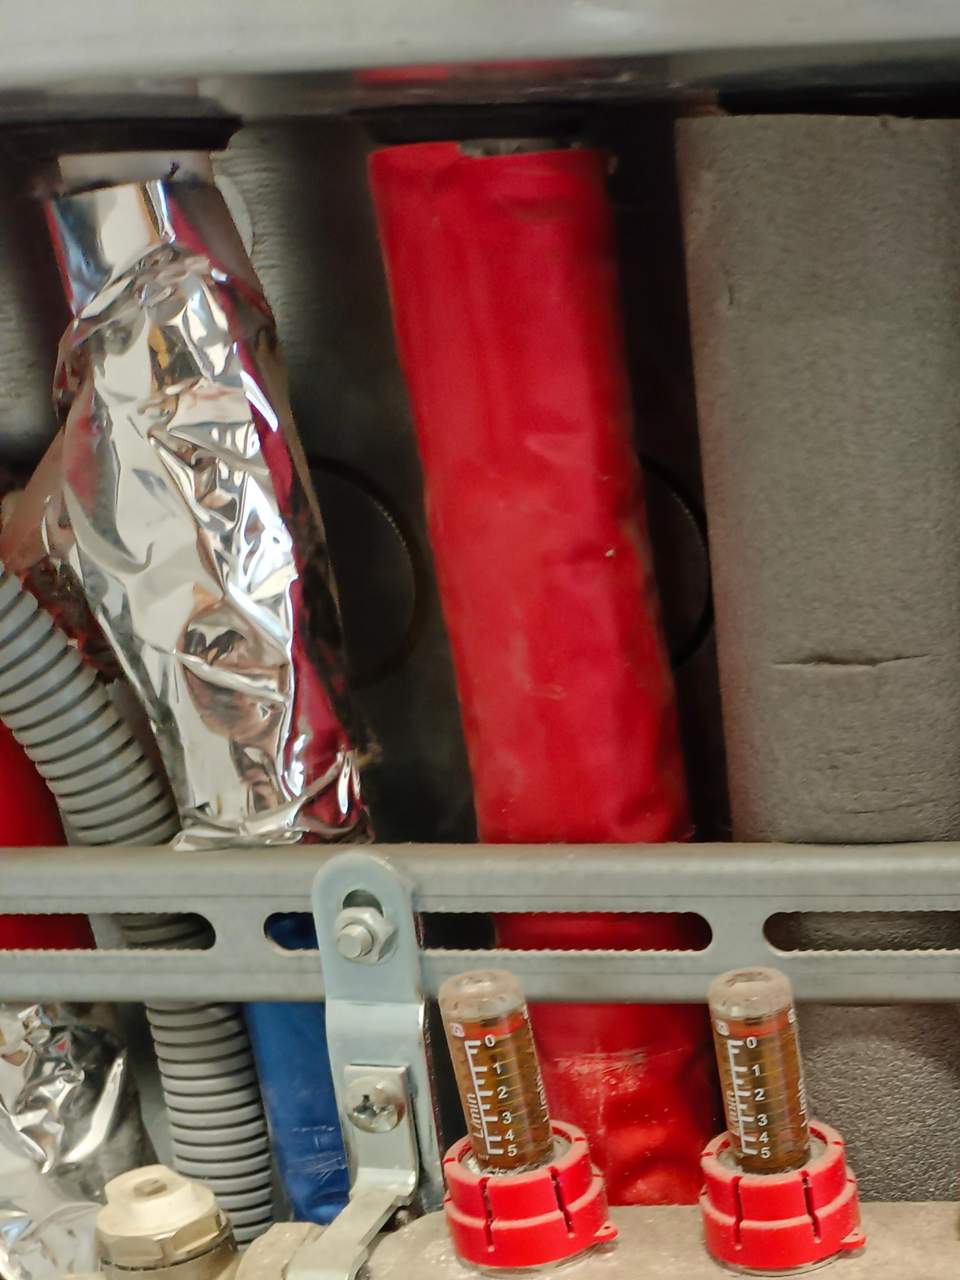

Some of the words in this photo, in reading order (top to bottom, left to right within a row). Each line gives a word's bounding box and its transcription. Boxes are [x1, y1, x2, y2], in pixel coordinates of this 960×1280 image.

[484, 1034, 495, 1047] 0
[746, 1036, 758, 1049] 0
[492, 1062, 502, 1075] 1
[752, 1064, 760, 1077] 1
[497, 1086, 508, 1099] 2
[754, 1088, 766, 1101] 2
[467, 1093, 484, 1138] L/min
[502, 1111, 513, 1125] 3
[757, 1114, 768, 1127] 3
[505, 1129, 515, 1141] 4
[759, 1131, 769, 1143] 4
[507, 1143, 518, 1157] 5
[760, 1147, 771, 1159] 5
